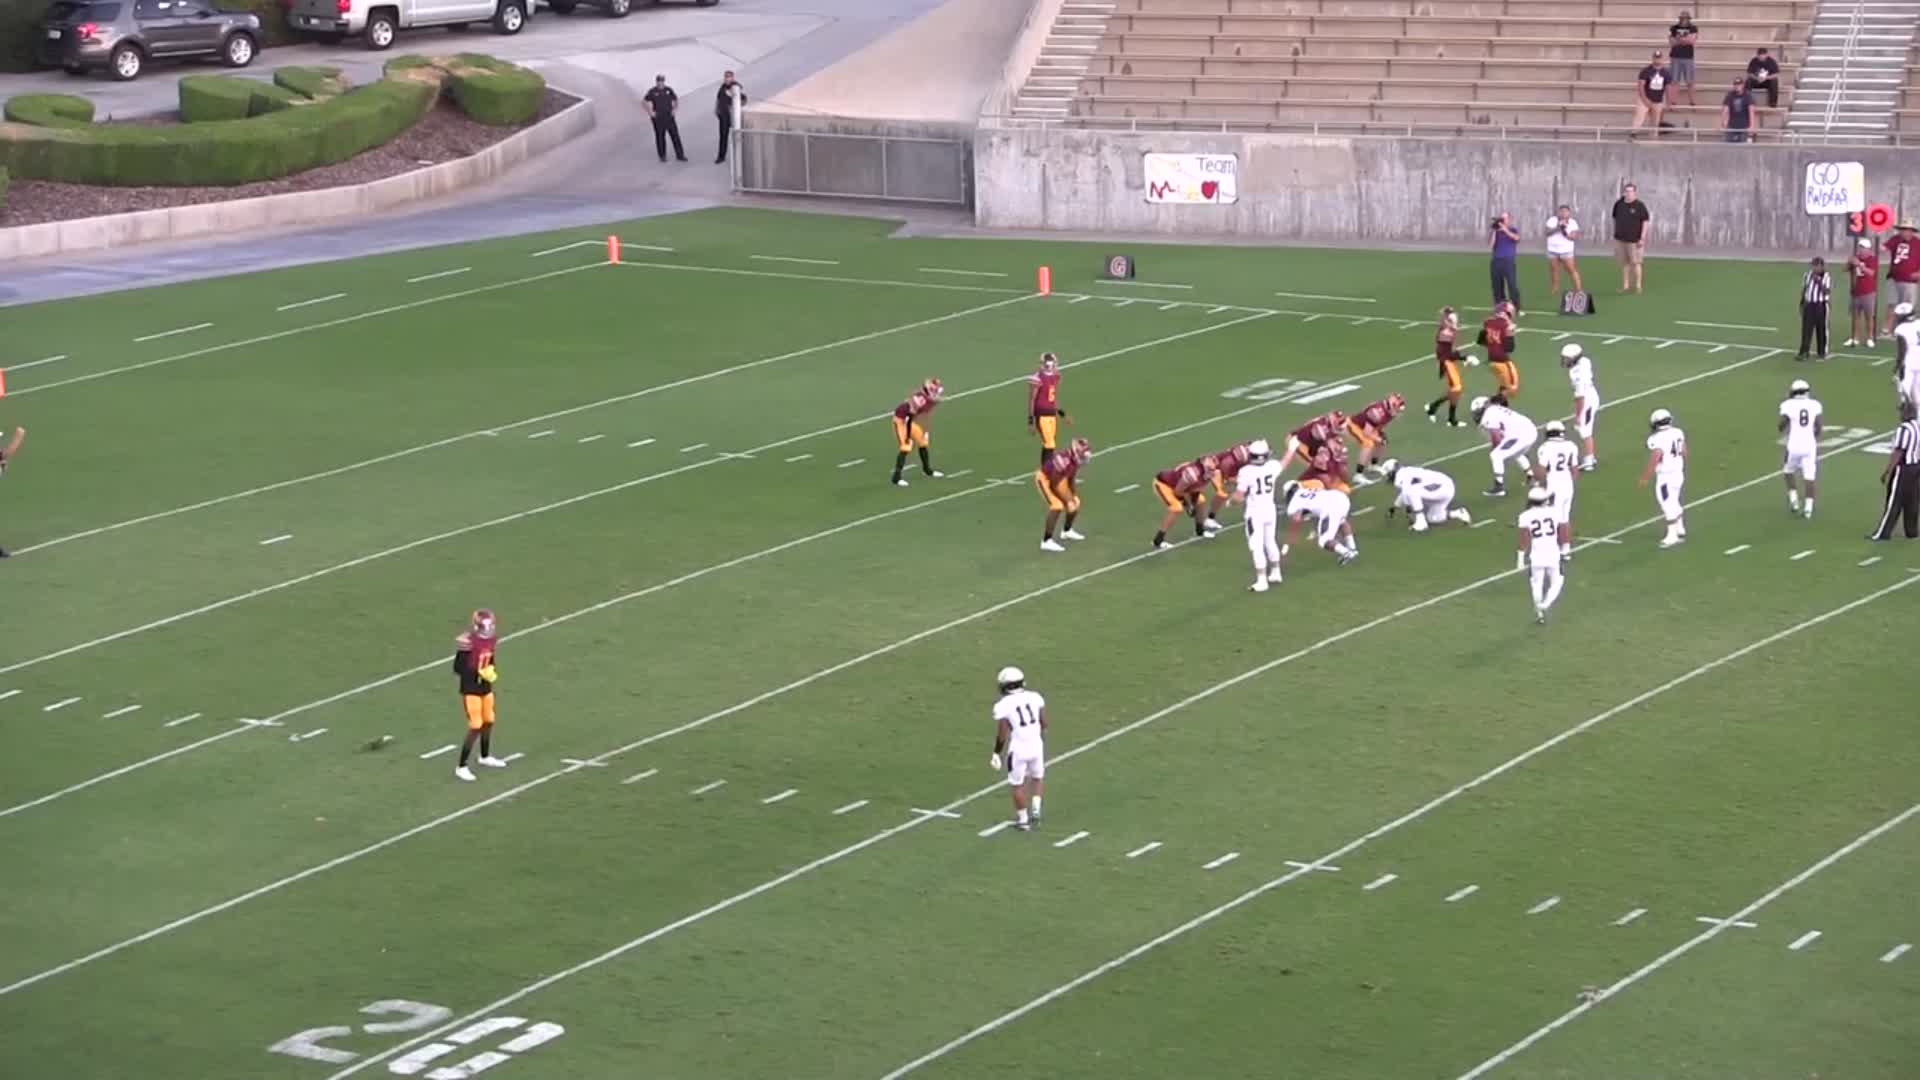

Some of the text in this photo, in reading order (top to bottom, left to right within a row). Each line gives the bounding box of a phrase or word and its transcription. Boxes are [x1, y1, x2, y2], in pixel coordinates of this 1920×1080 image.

[1195, 156, 1236, 174] Team
[1811, 161, 1840, 186] GO
[1849, 212, 1864, 233] 3
[1110, 255, 1127, 278] G
[1564, 290, 1588, 314] 10
[1799, 408, 1809, 427] 8
[1255, 474, 1274, 495] 15
[1530, 517, 1556, 538] 23
[1016, 703, 1037, 727] 11
